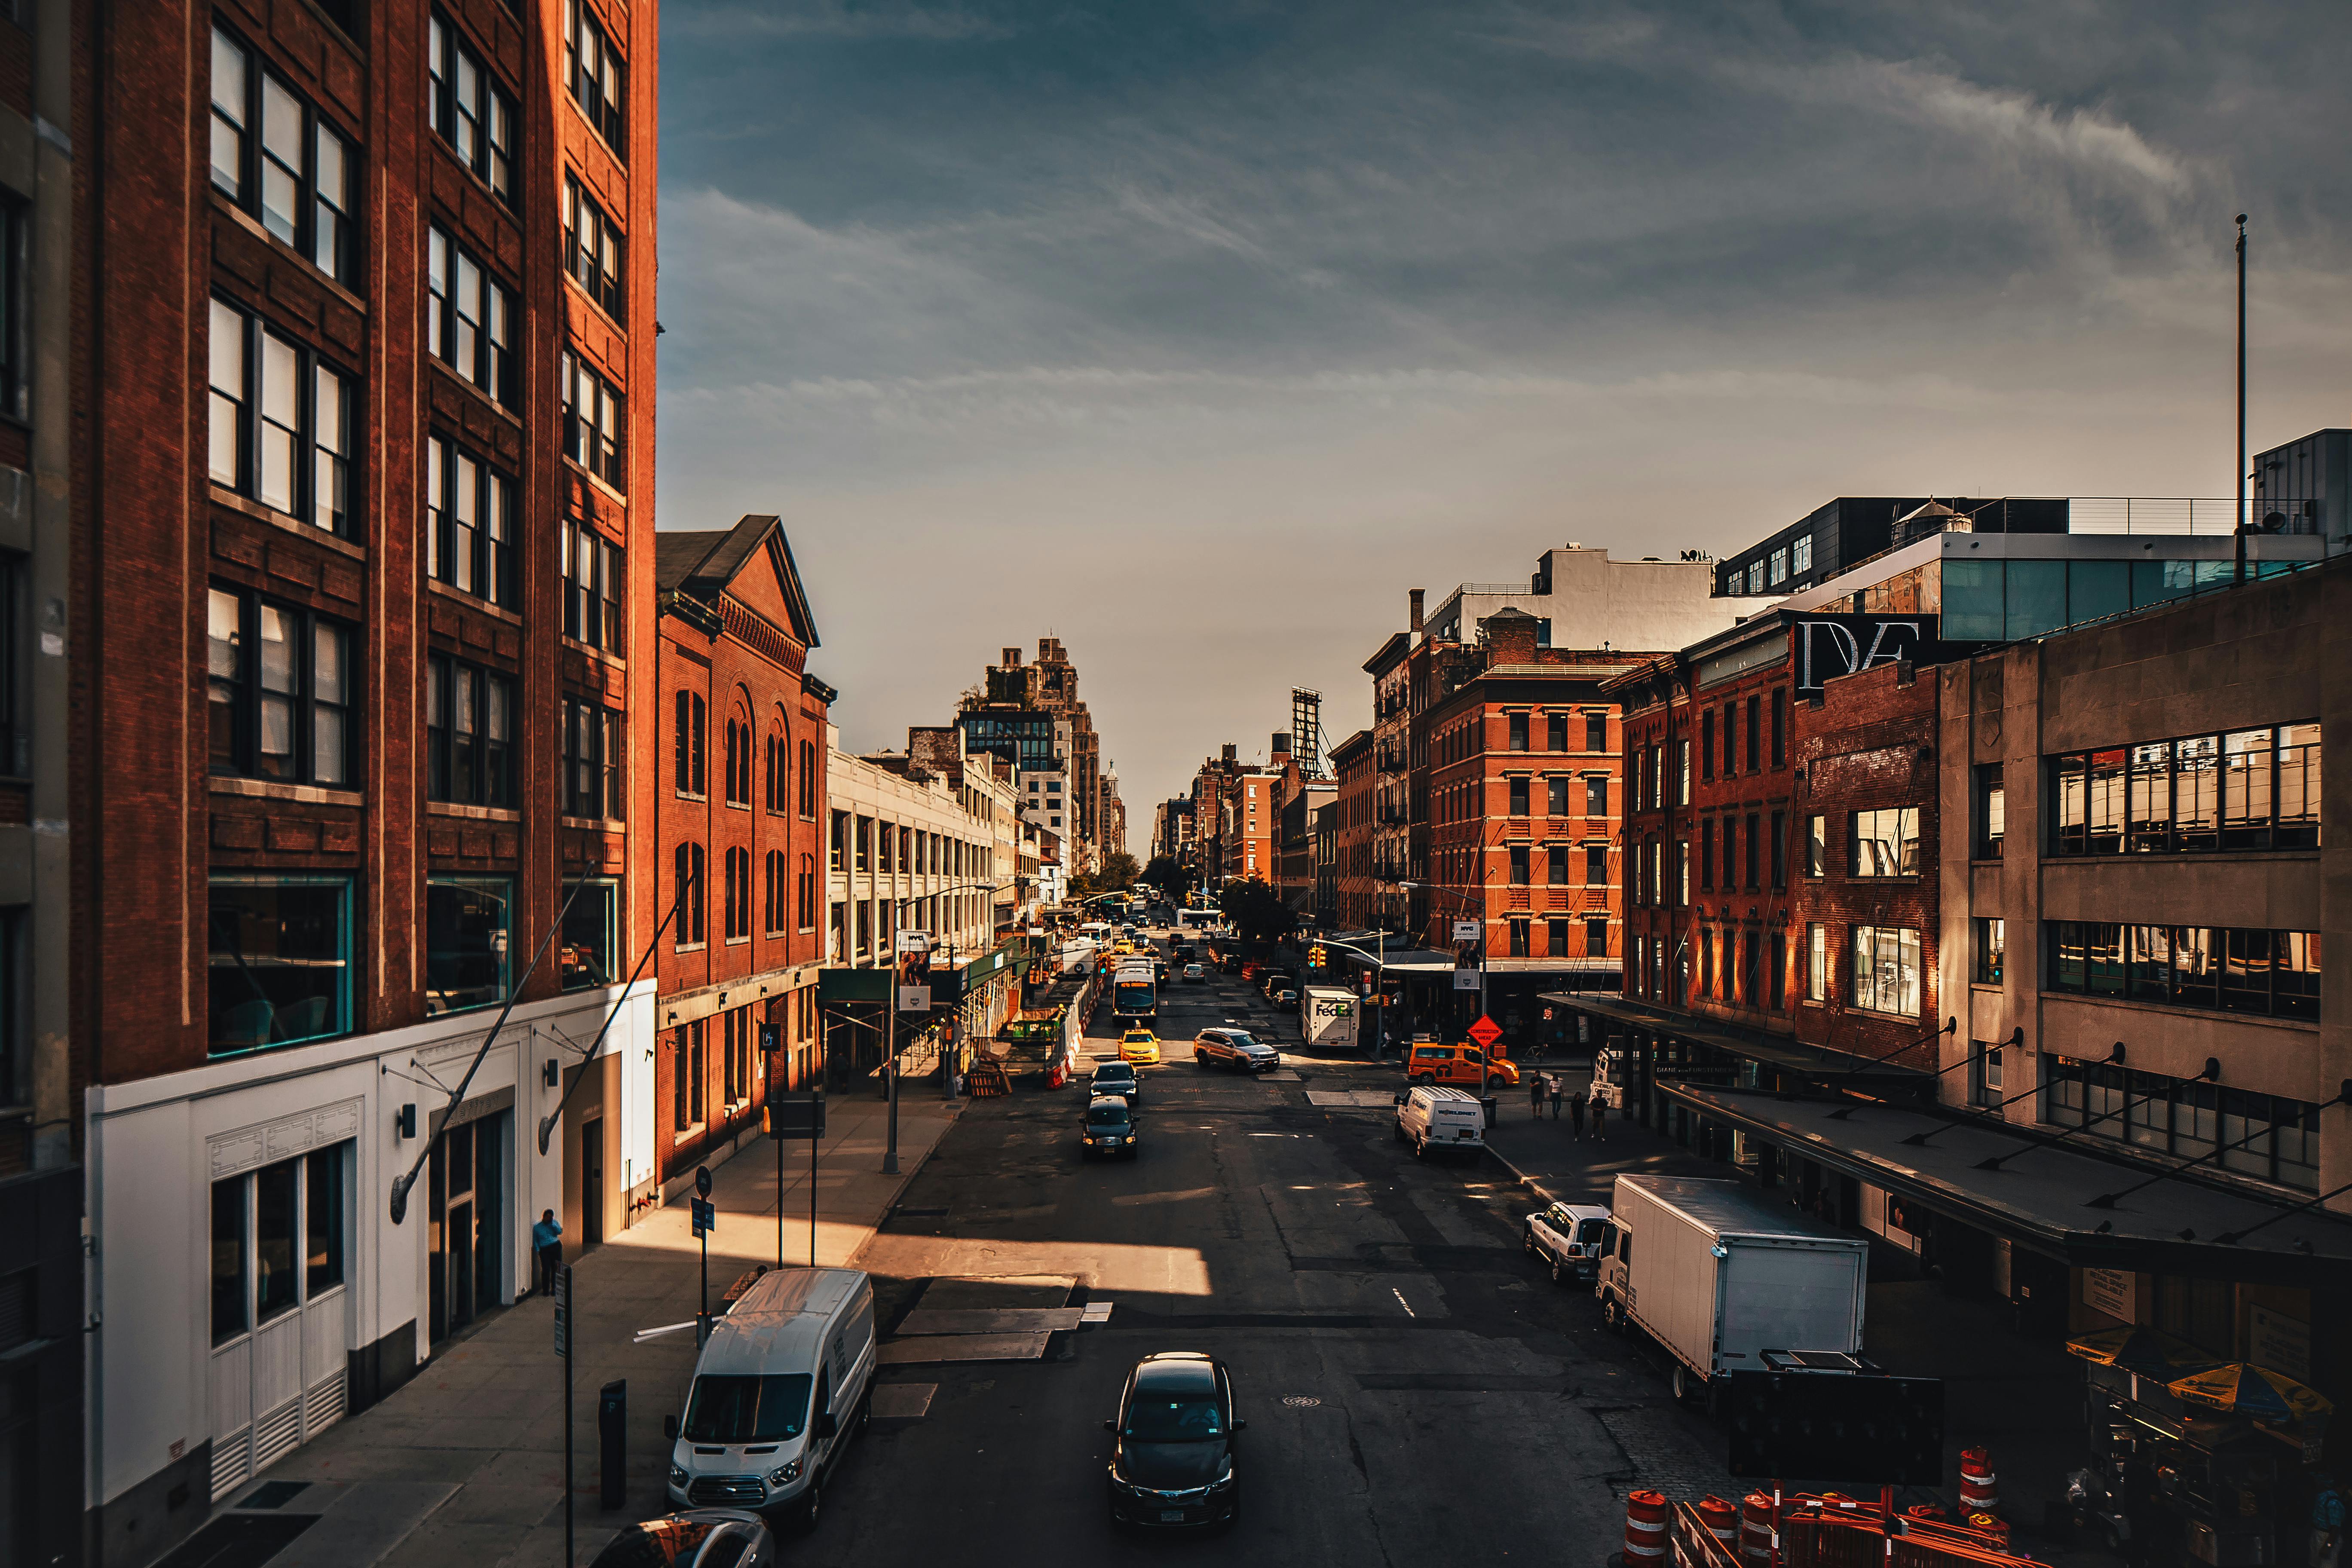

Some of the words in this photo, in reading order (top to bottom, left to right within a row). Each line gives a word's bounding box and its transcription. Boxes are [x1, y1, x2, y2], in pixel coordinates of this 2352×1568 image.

[1316, 1004, 1354, 1017] FedEx
[2094, 1280, 2123, 1296] AVAILABLE
[609, 1402, 616, 1413] P
